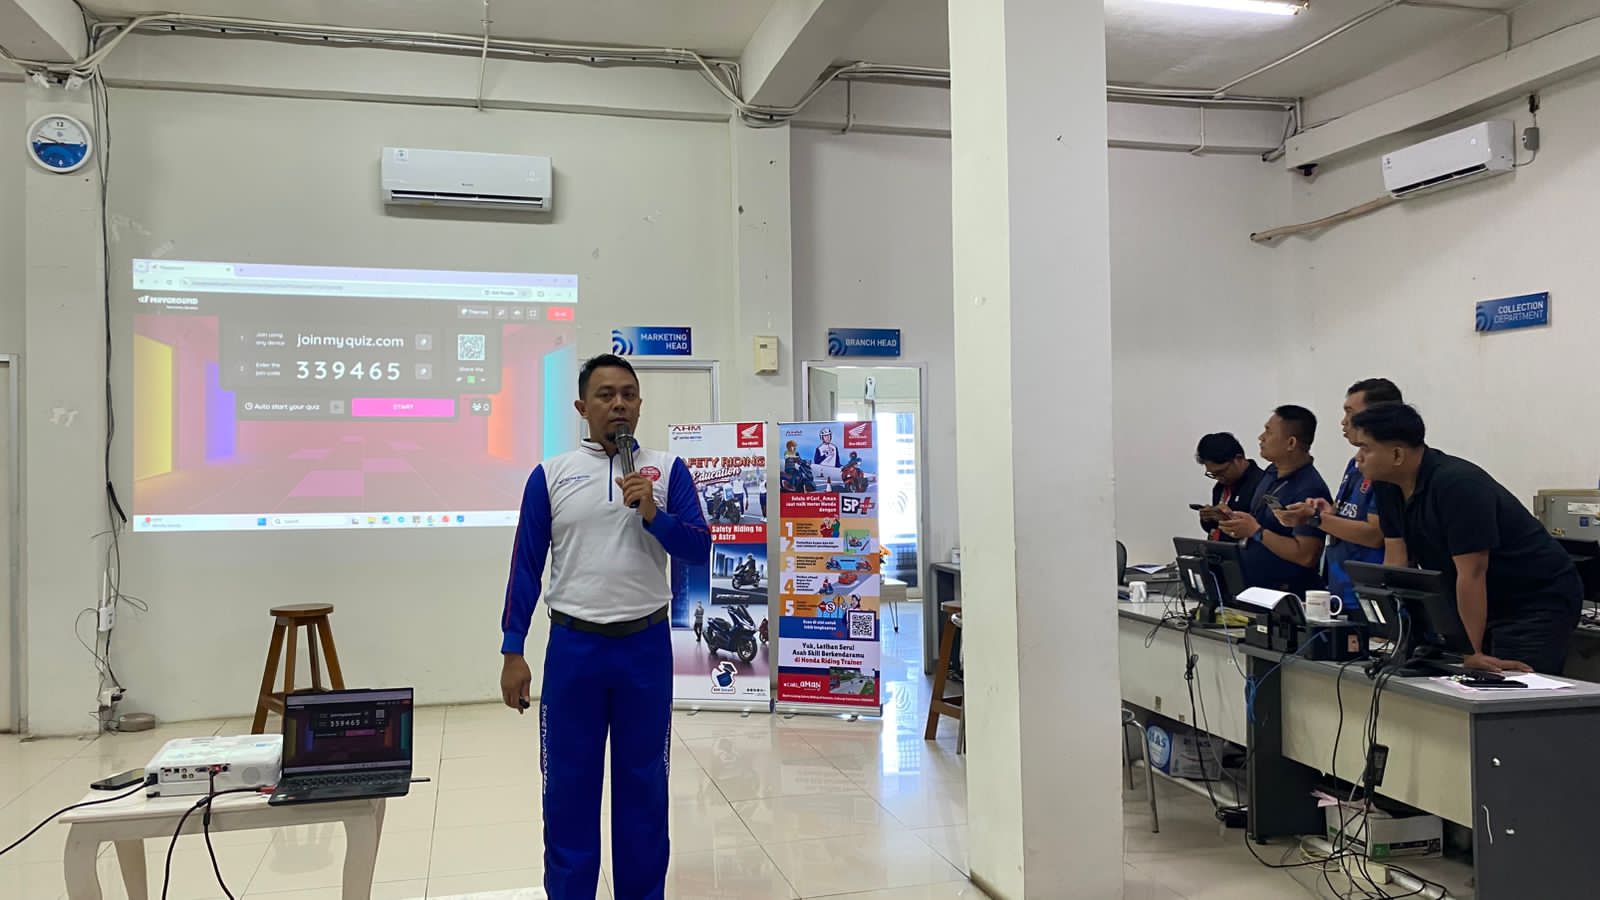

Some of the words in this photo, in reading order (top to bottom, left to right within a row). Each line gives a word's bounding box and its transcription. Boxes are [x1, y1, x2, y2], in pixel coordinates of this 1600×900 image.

[1497, 301, 1544, 314] COLLECTION
[1494, 309, 1544, 324] DEPARTMENT
[640, 333, 687, 342] MARKETING
[845, 338, 876, 347] BRANCH
[877, 338, 897, 347] HEAD
[665, 342, 688, 350] HEAD
[296, 360, 400, 381] 339465
[254, 402, 270, 410] Auto
[271, 402, 288, 410] start
[289, 403, 304, 412] your
[305, 403, 320, 411] quiz
[685, 457, 720, 468] FETY
[721, 456, 766, 468] RIDING
[692, 467, 742, 481] Education
[711, 525, 732, 533] Safety
[733, 525, 754, 533] Riding
[785, 522, 793, 537] 1
[784, 579, 795, 593] 4
[785, 599, 794, 616] 5
[802, 642, 815, 650] Yuk,
[821, 650, 864, 659] Berkendaramu
[821, 657, 840, 666] Riding
[841, 658, 862, 666] Trainer
